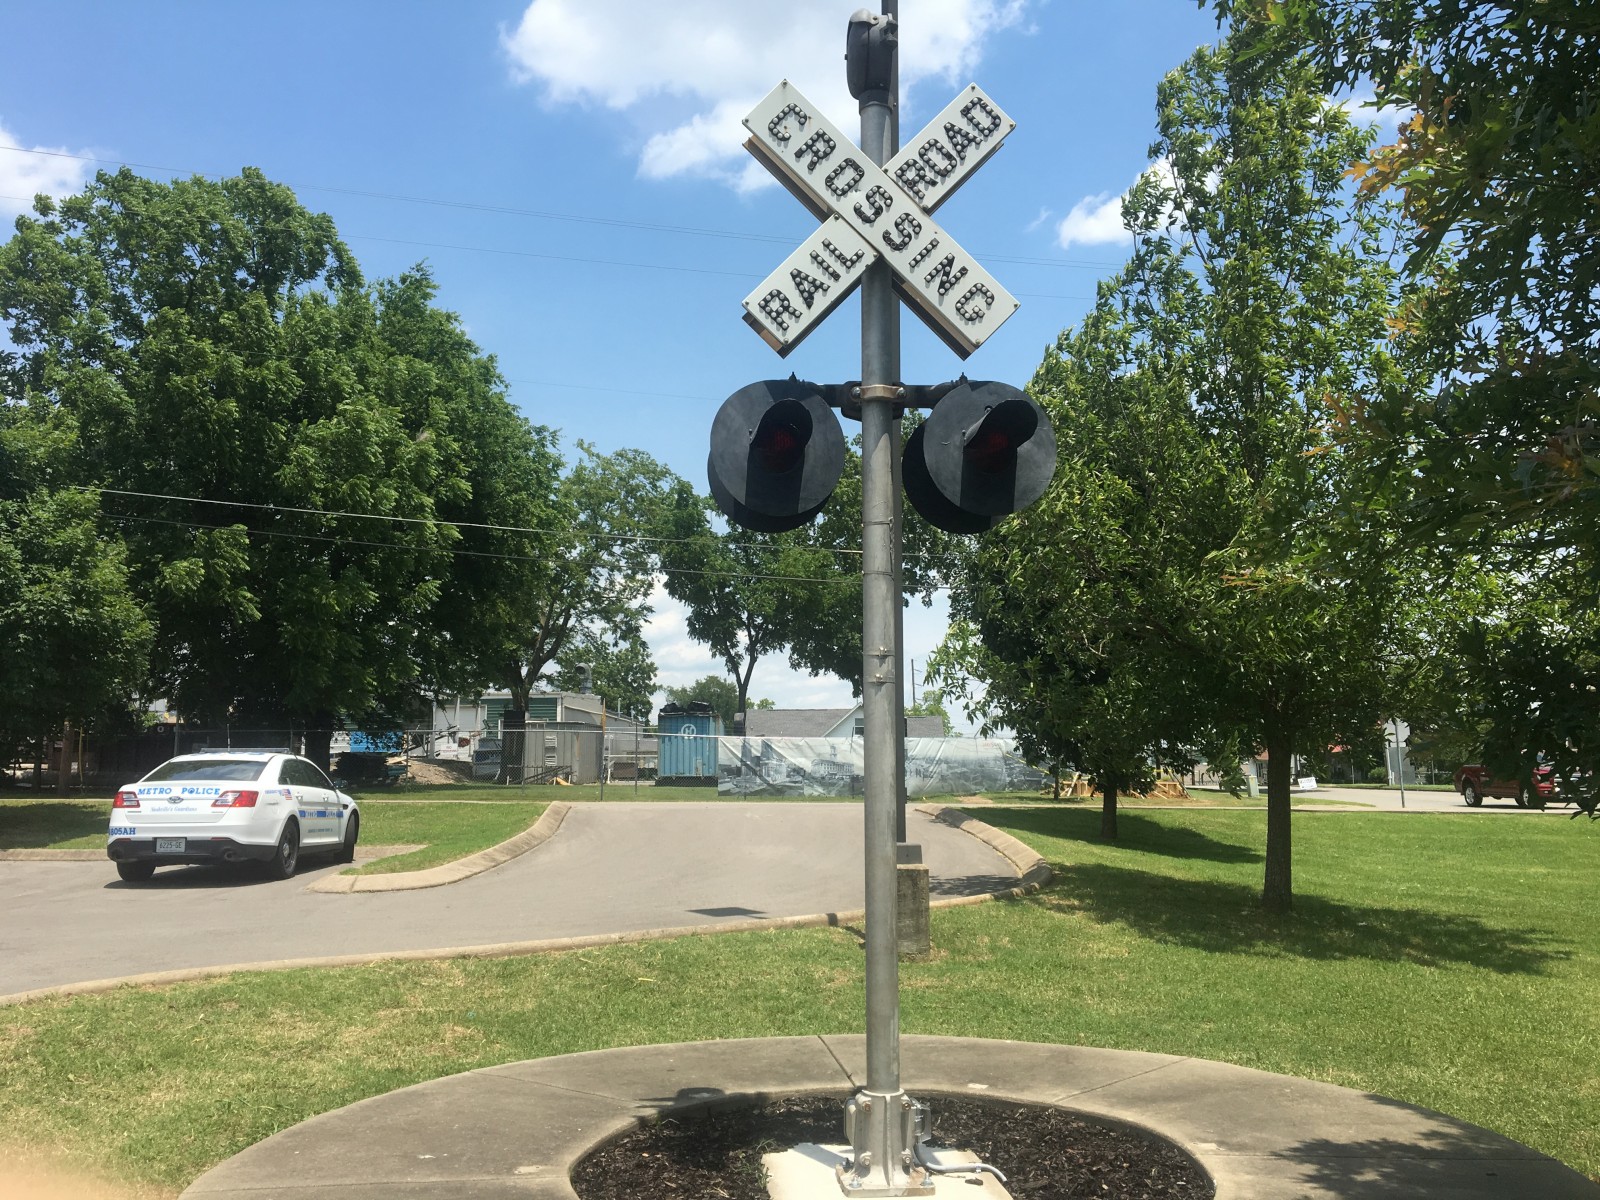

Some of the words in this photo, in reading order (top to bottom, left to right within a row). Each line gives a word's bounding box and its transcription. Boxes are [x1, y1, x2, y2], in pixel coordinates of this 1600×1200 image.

[757, 238, 864, 331] RAIL
[894, 96, 1001, 200] ROAD
[768, 102, 995, 322] CROSSING
[137, 788, 172, 796] METRO
[181, 787, 221, 796] POLICE
